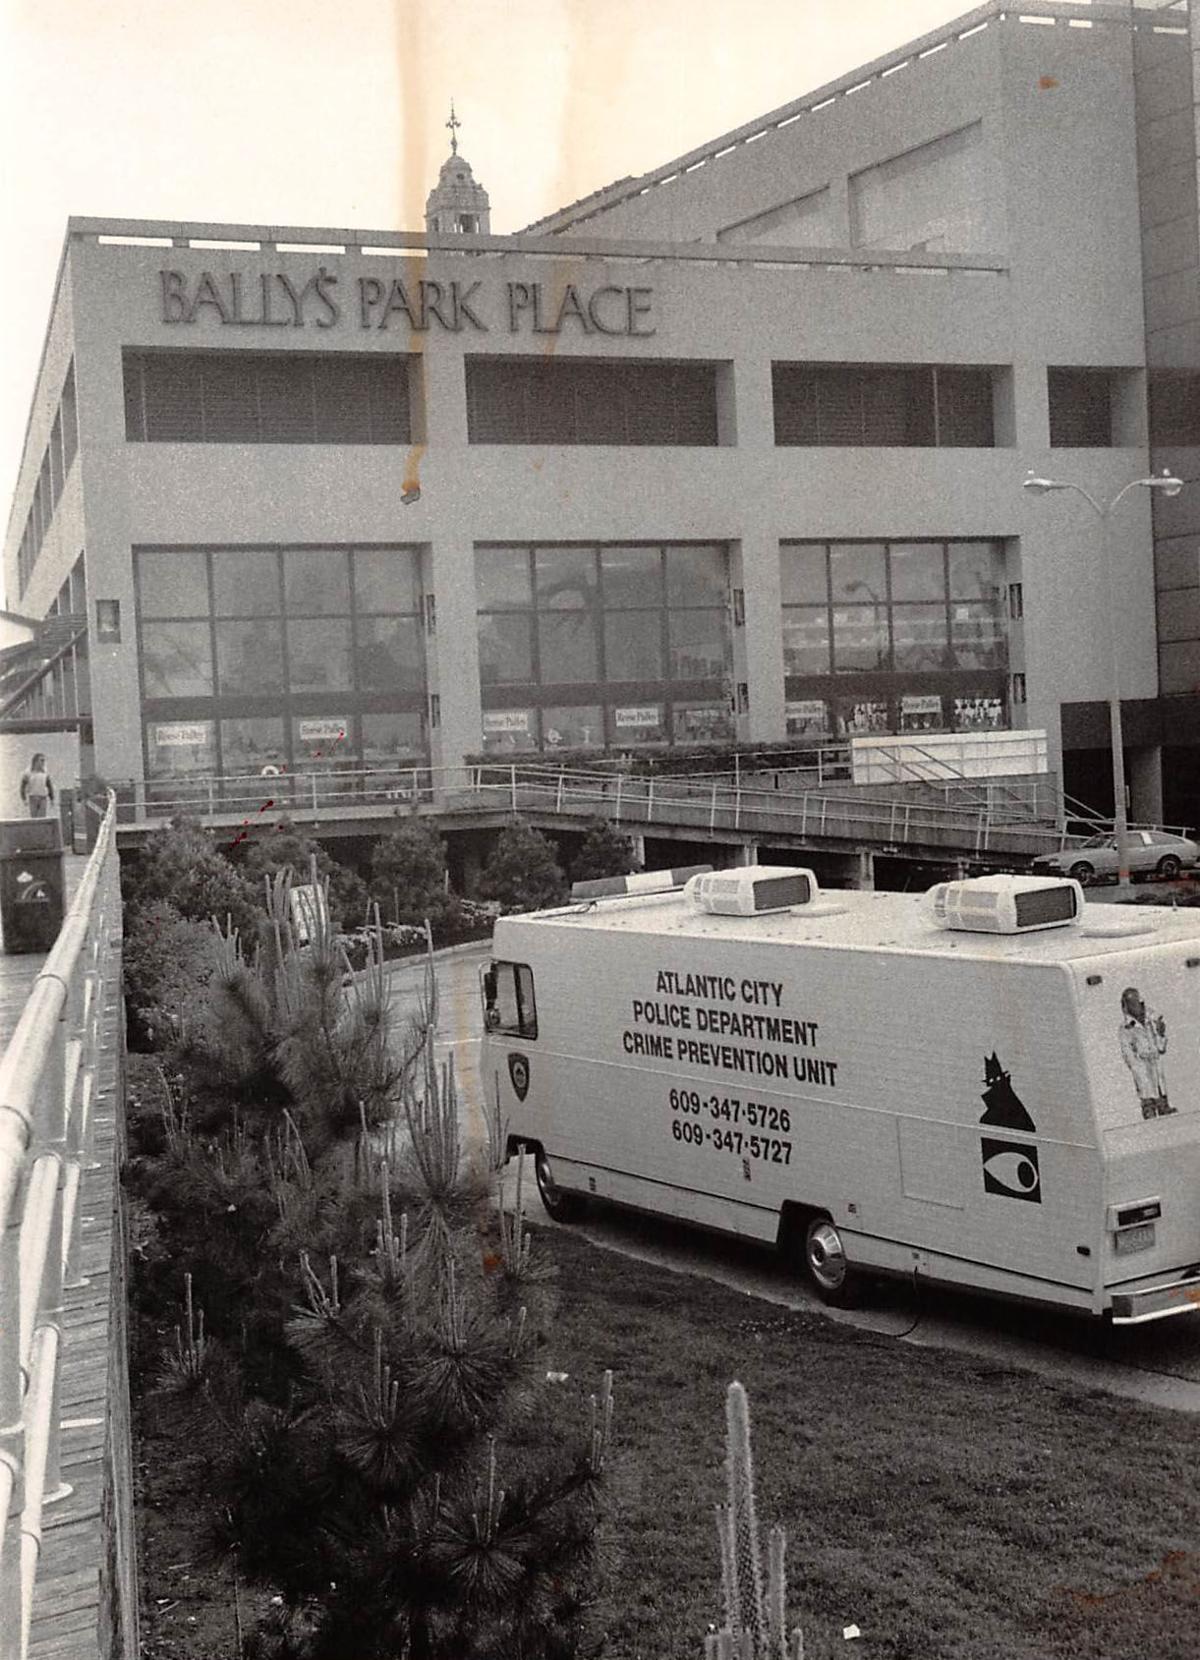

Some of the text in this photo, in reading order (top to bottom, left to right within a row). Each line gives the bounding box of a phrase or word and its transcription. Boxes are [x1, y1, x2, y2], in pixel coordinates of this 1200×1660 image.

[160, 267, 657, 337] BALLY'S PARK PLACE
[657, 970, 783, 1007] ATLANTIC CITY
[633, 1000, 818, 1047] POLICE DEPARTMENT
[623, 1031, 838, 1087] CRIME PREVENTION UNIT
